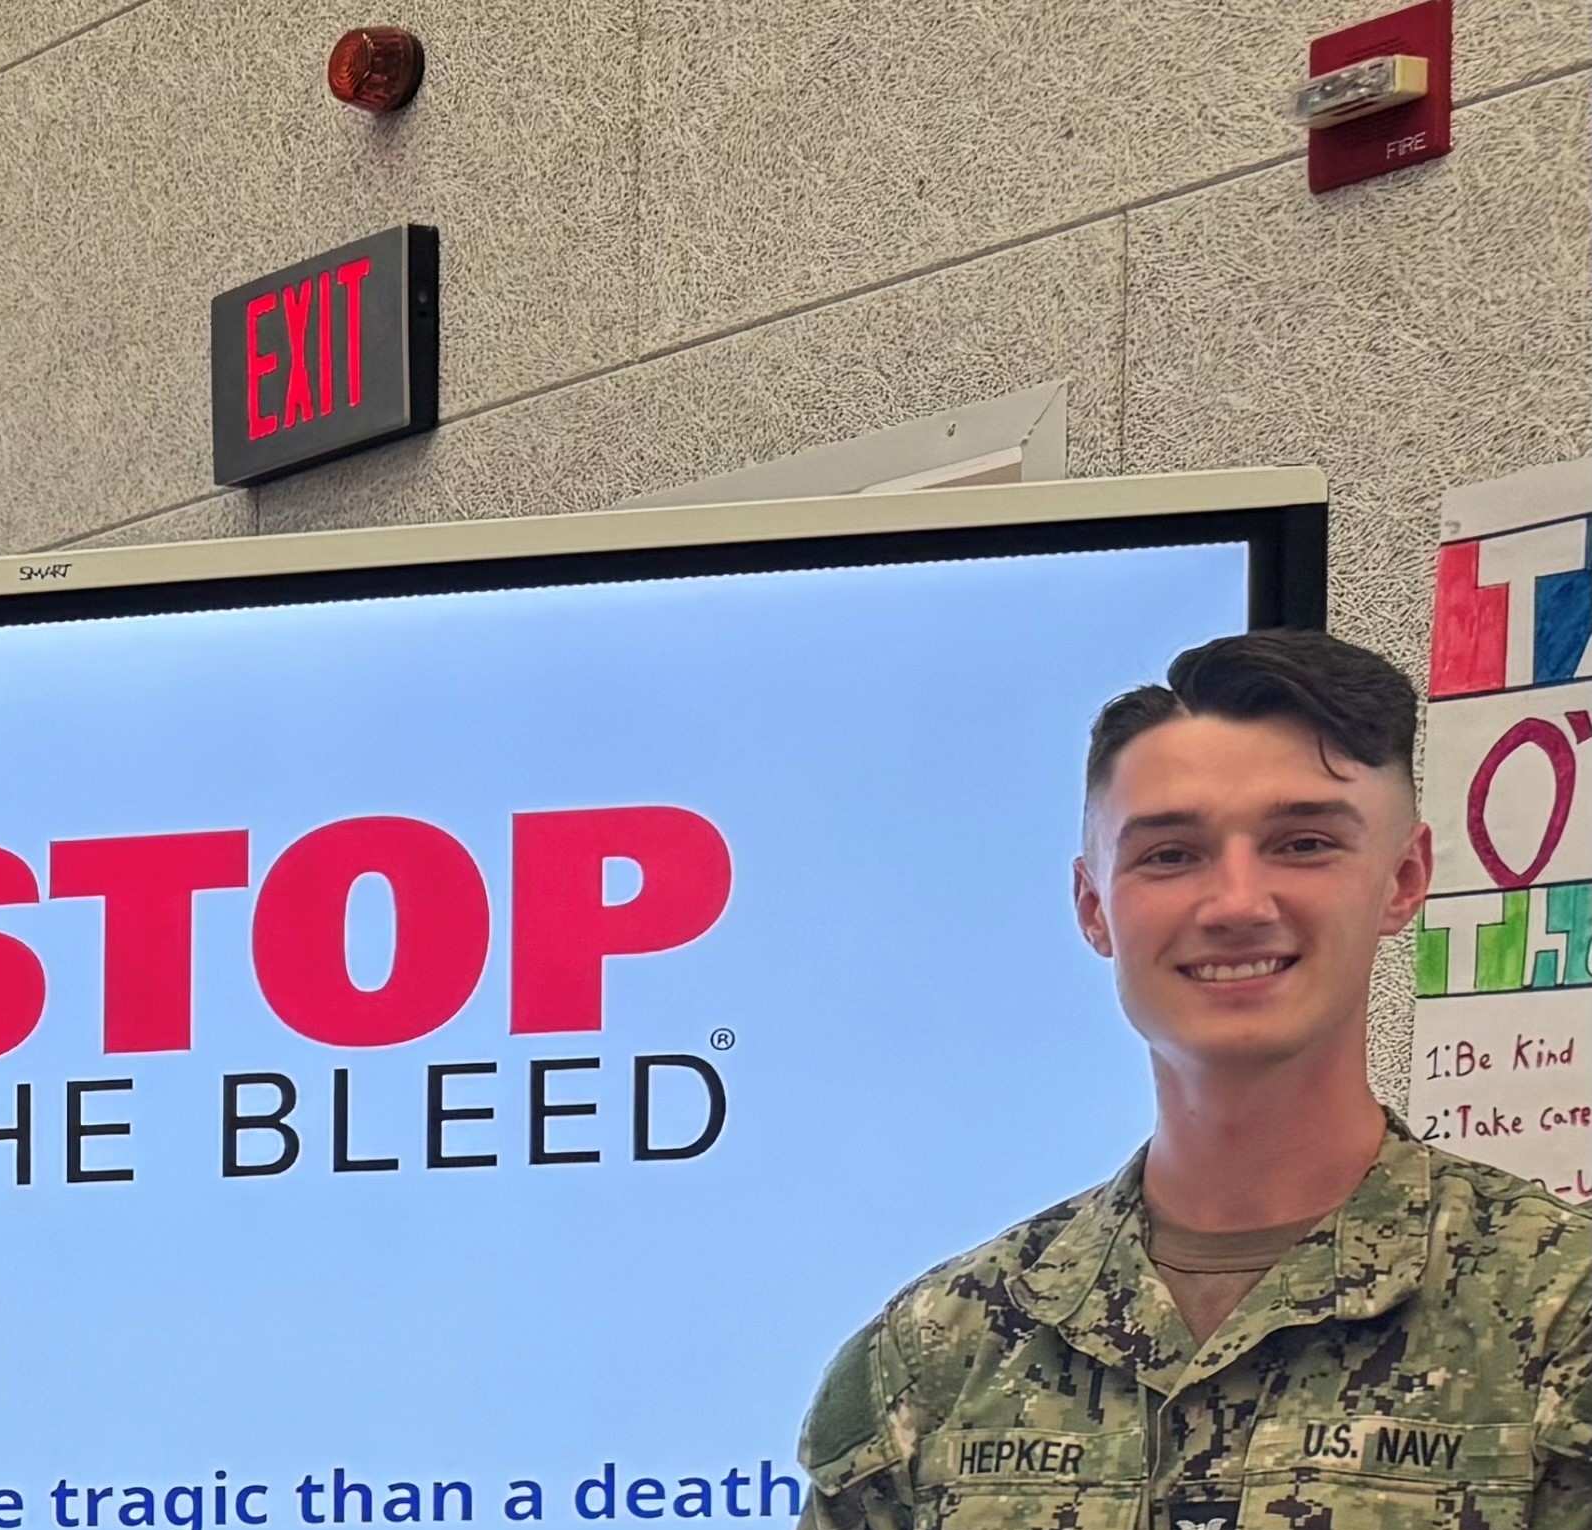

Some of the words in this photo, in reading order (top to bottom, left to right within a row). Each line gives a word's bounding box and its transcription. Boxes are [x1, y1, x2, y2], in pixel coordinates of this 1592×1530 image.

[1386, 131, 1427, 159] FIRE
[246, 256, 373, 441] EXIT
[221, 1052, 729, 1179] BLEED
[959, 1439, 1085, 1475] HEPKER
[1303, 1423, 1358, 1459] U.S.
[1376, 1426, 1464, 1470] NAVY
[295, 1467, 473, 1524] than
[504, 1480, 544, 1521] a
[573, 1460, 801, 1519] death
